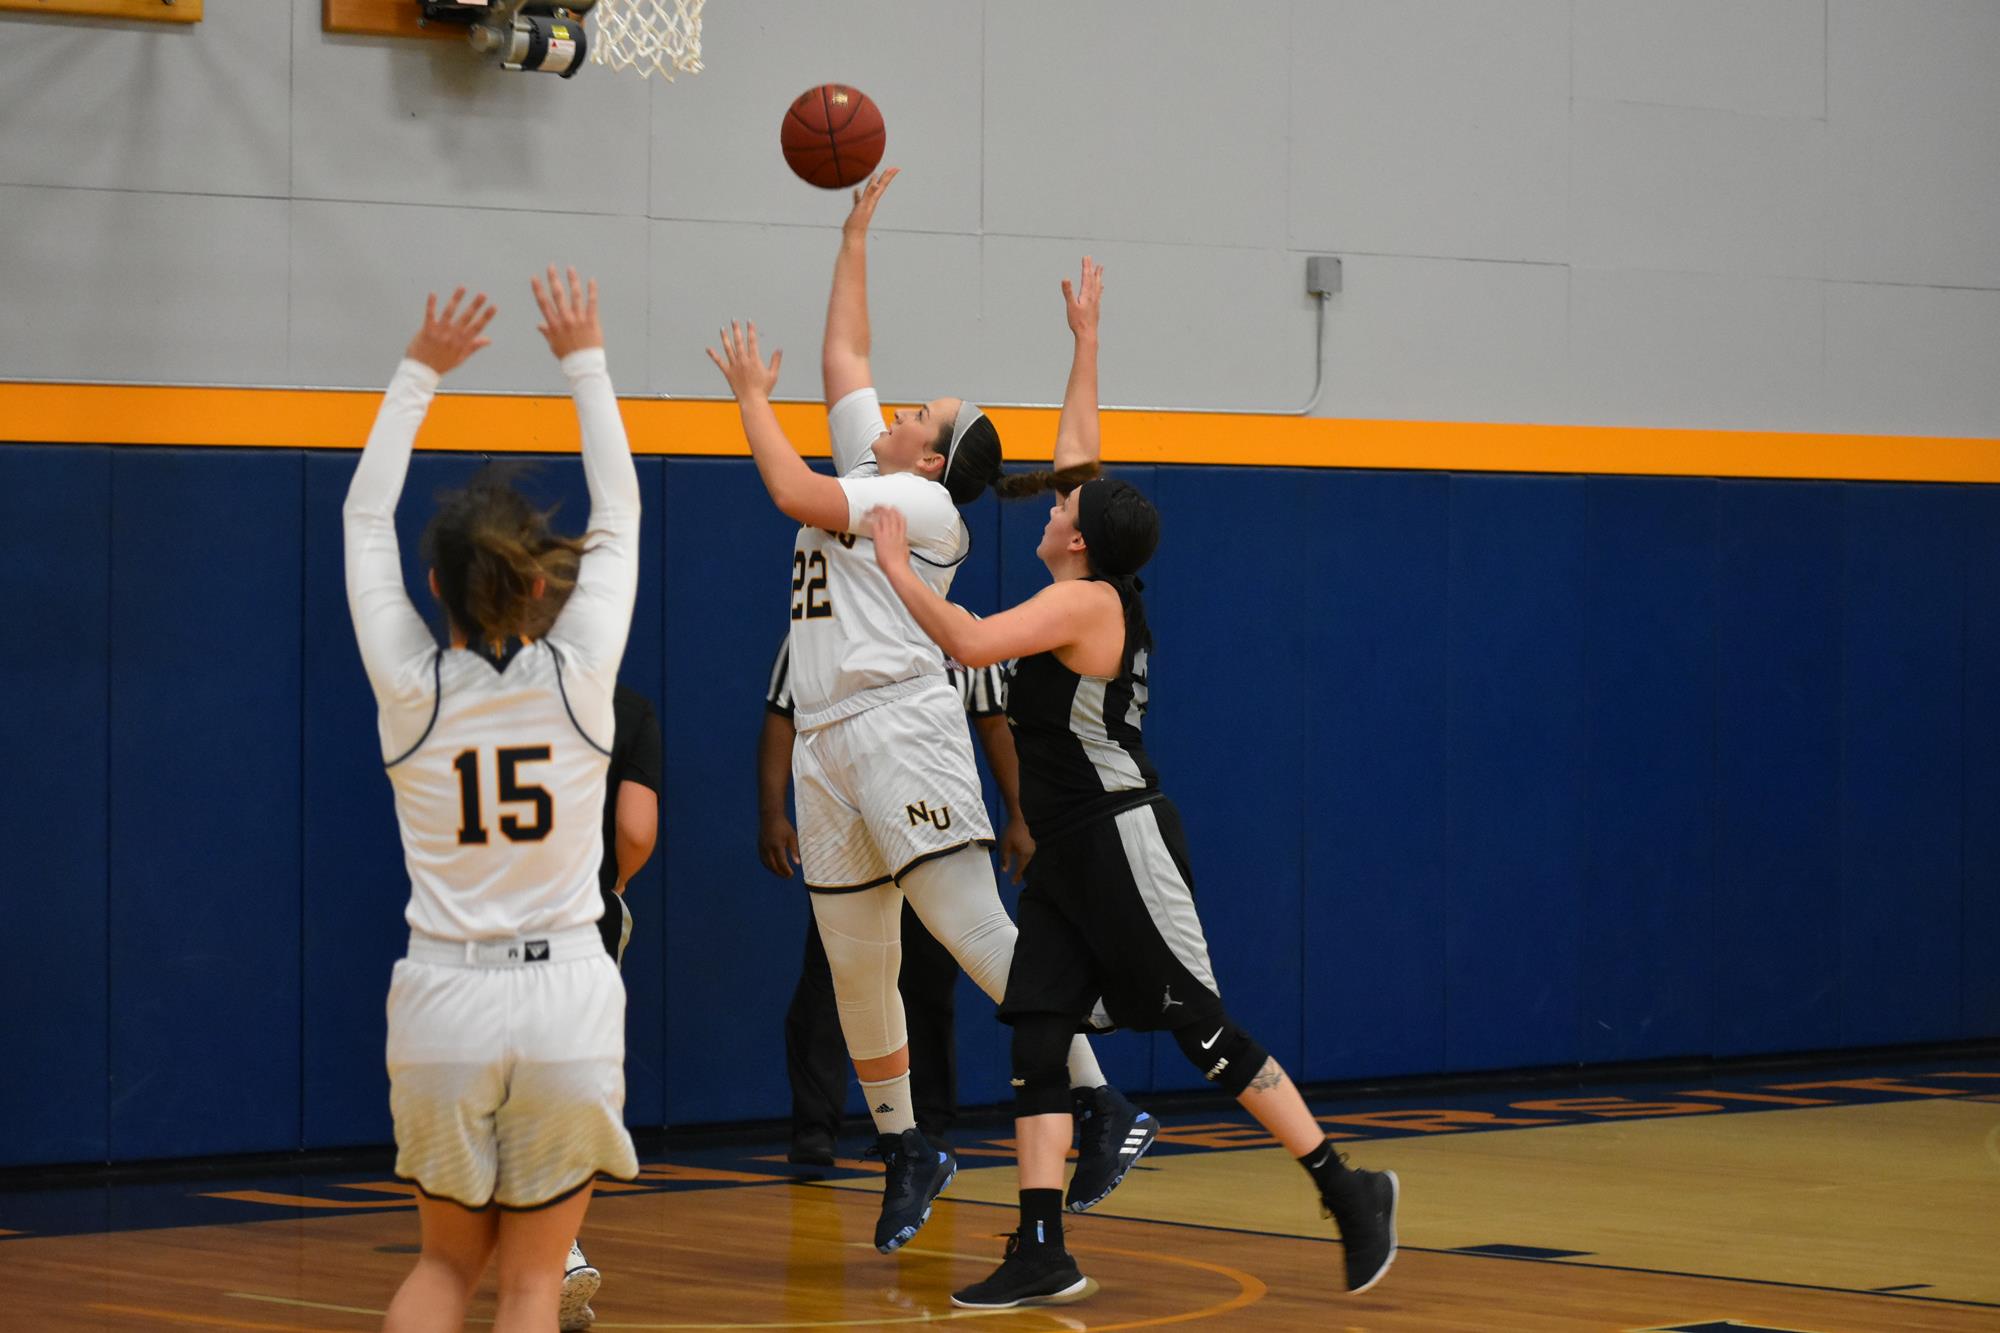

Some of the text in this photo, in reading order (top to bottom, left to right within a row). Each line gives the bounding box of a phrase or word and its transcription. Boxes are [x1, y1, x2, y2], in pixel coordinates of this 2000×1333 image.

[790, 549, 833, 620] 22
[453, 742, 554, 845] 15
[905, 800, 951, 831] NU
